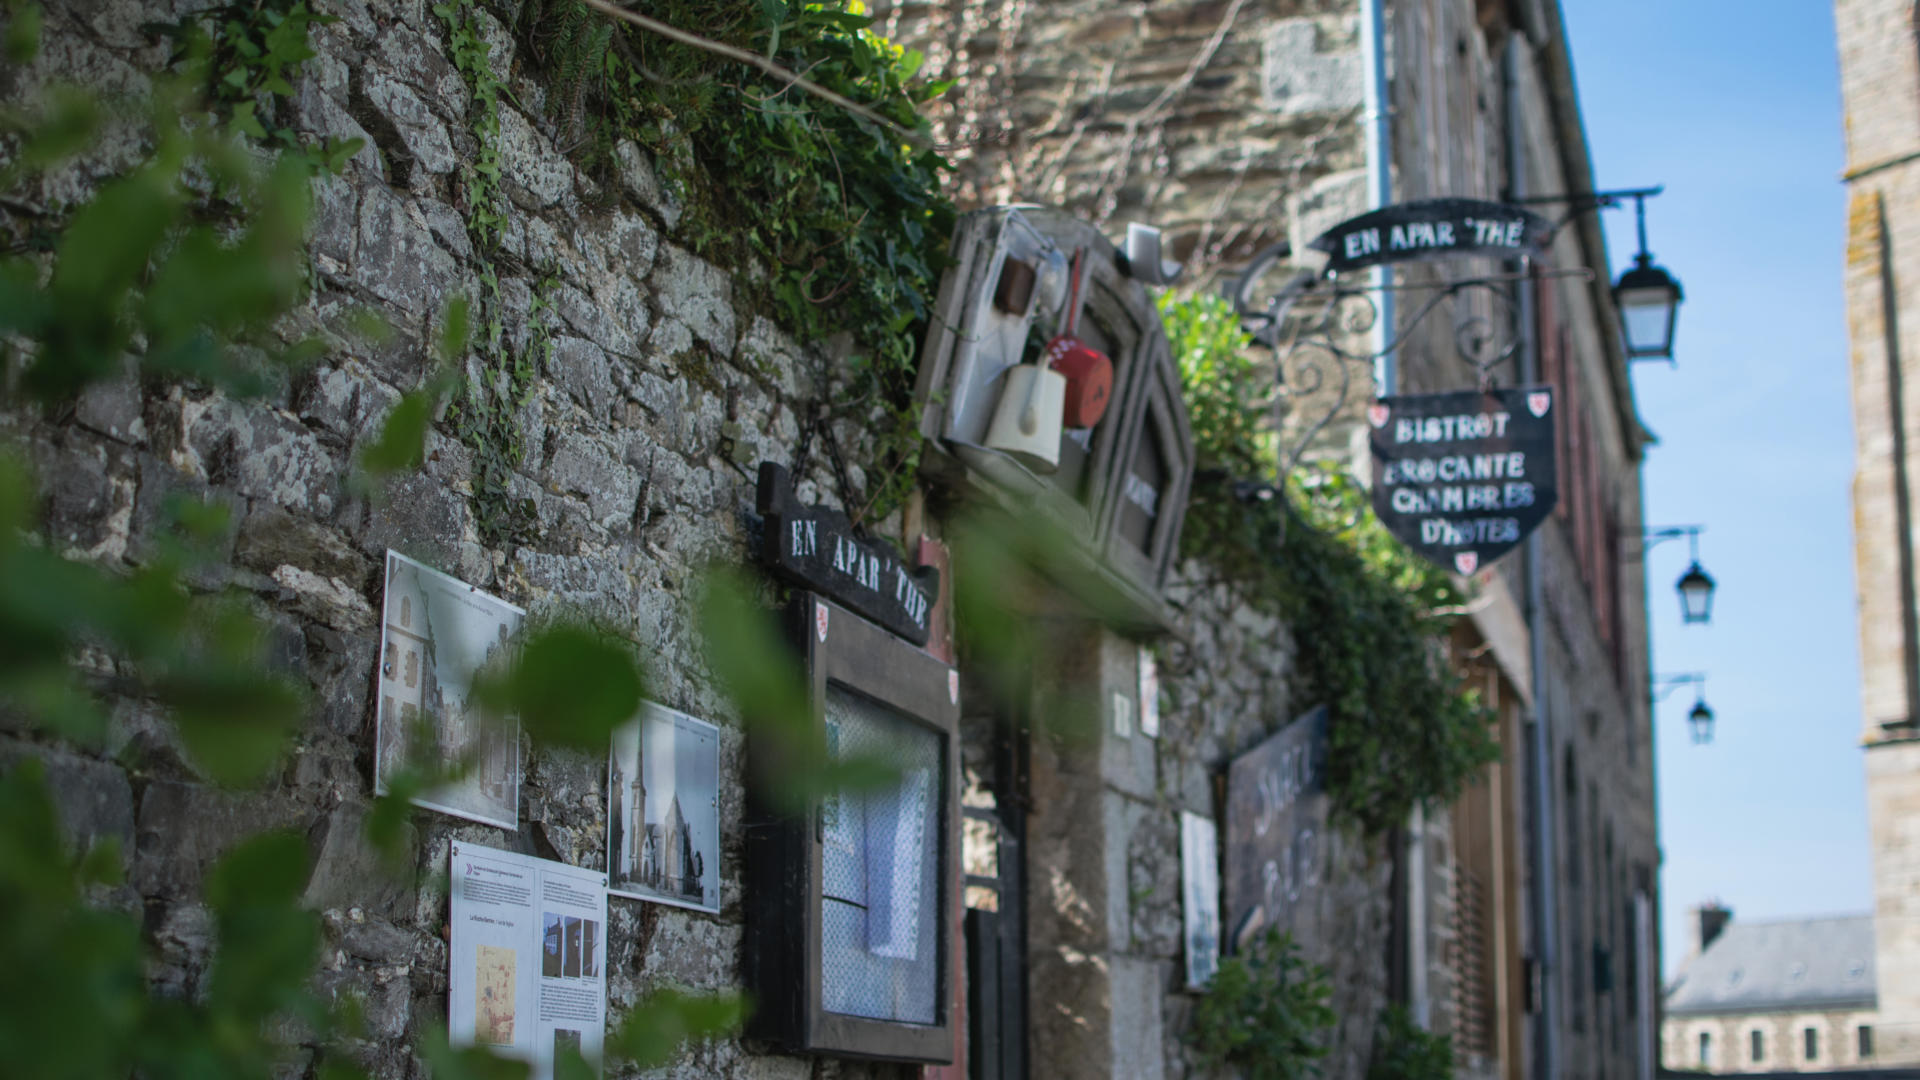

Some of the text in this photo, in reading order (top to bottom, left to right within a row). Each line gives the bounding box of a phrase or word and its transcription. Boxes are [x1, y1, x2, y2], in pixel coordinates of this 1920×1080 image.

[1344, 228, 1380, 260] EN
[1390, 221, 1456, 250] APAR
[1395, 412, 1511, 443] BISTROT
[1383, 451, 1525, 485] BROCANTE
[791, 519, 817, 557] EN
